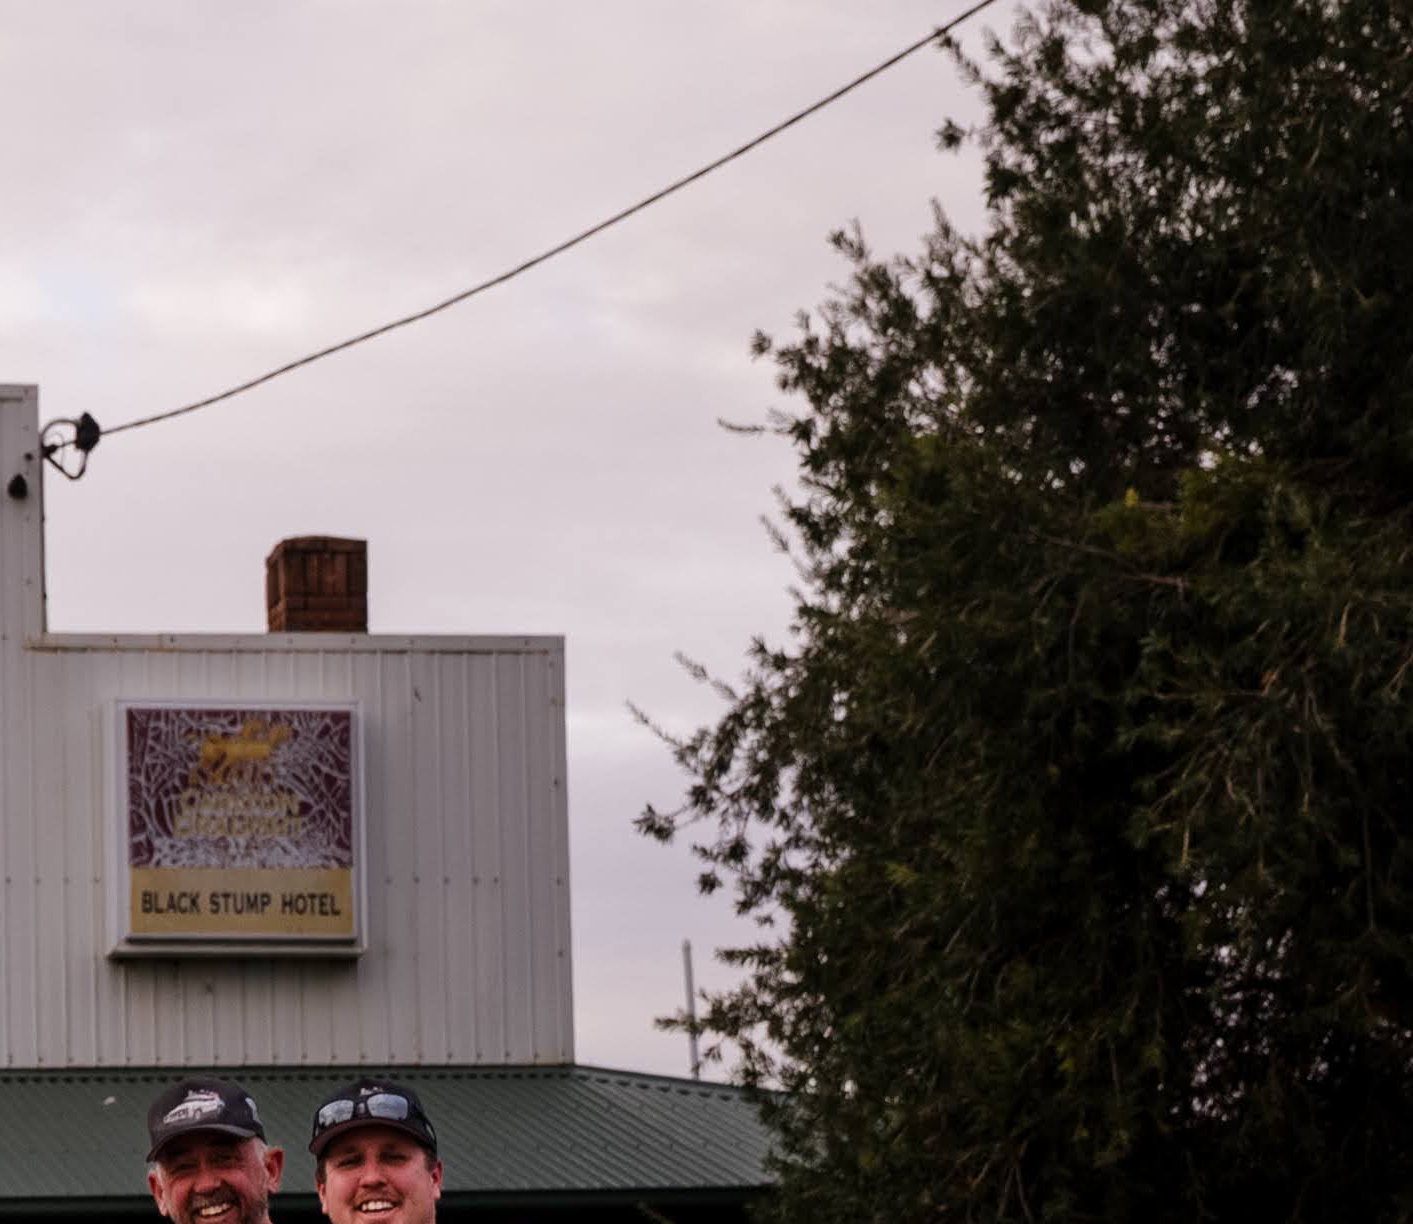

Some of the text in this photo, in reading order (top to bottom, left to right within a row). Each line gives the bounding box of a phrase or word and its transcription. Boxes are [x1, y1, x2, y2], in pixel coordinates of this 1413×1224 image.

[141, 891, 341, 916] BLACK STUMP HOTEL
